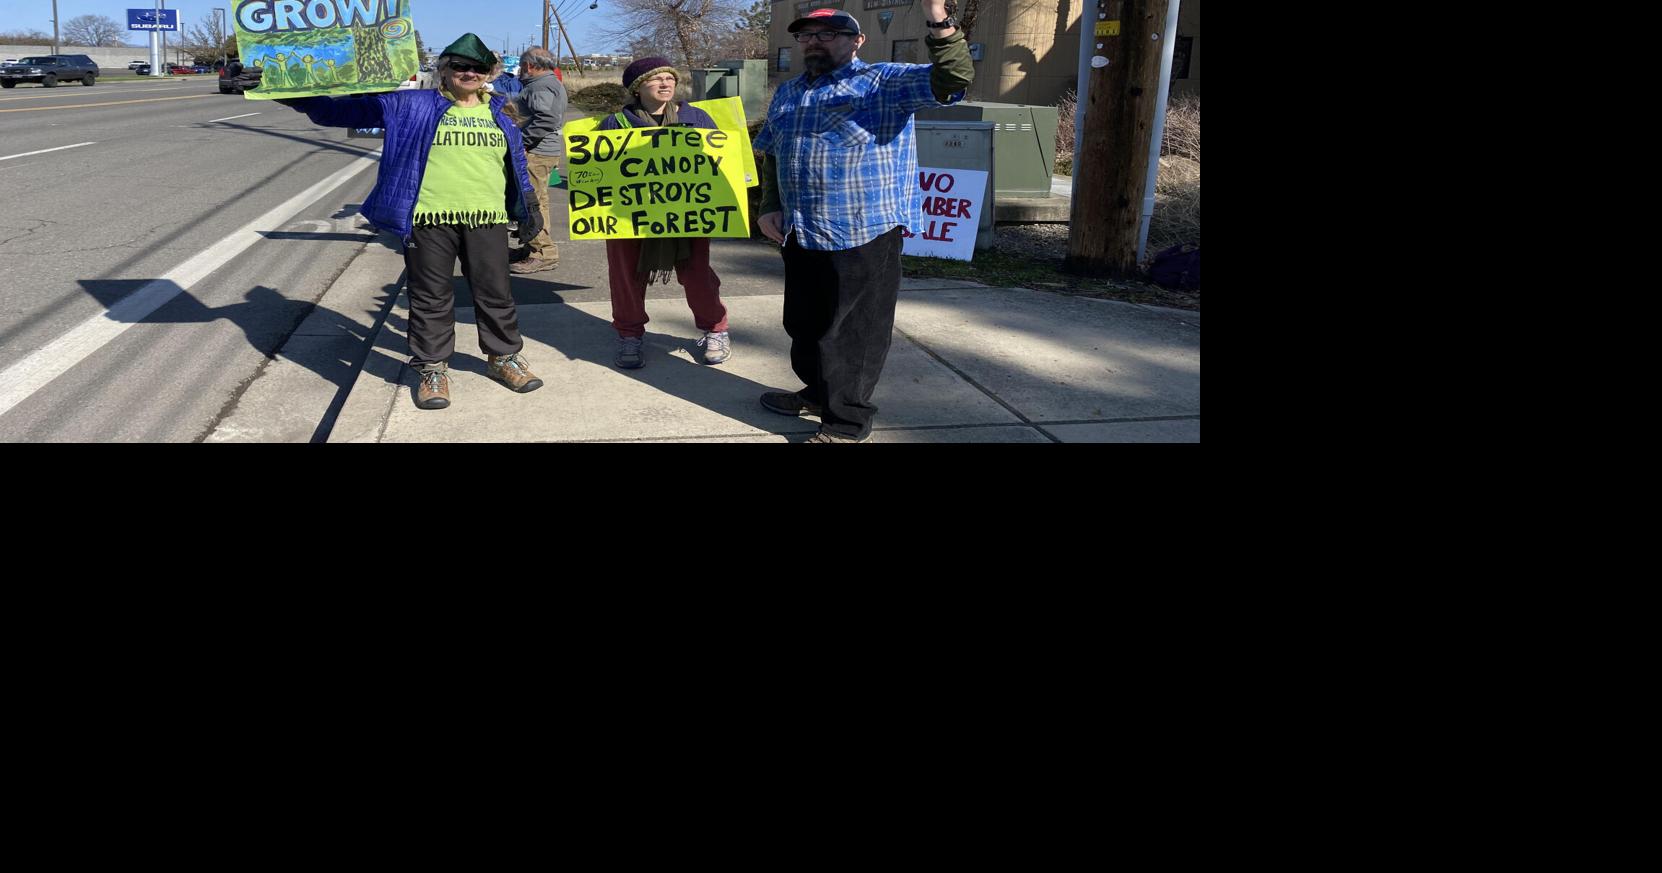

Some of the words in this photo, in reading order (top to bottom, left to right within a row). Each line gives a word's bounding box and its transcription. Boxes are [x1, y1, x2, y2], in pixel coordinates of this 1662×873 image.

[236, 0, 400, 33] GROW!
[440, 115, 458, 126] REES
[459, 117, 477, 128] HAVE
[568, 131, 634, 165] 30%
[641, 128, 728, 149] Tree
[620, 154, 723, 178] CANOPY
[922, 196, 972, 219] MBER
[571, 215, 618, 235] OUR
